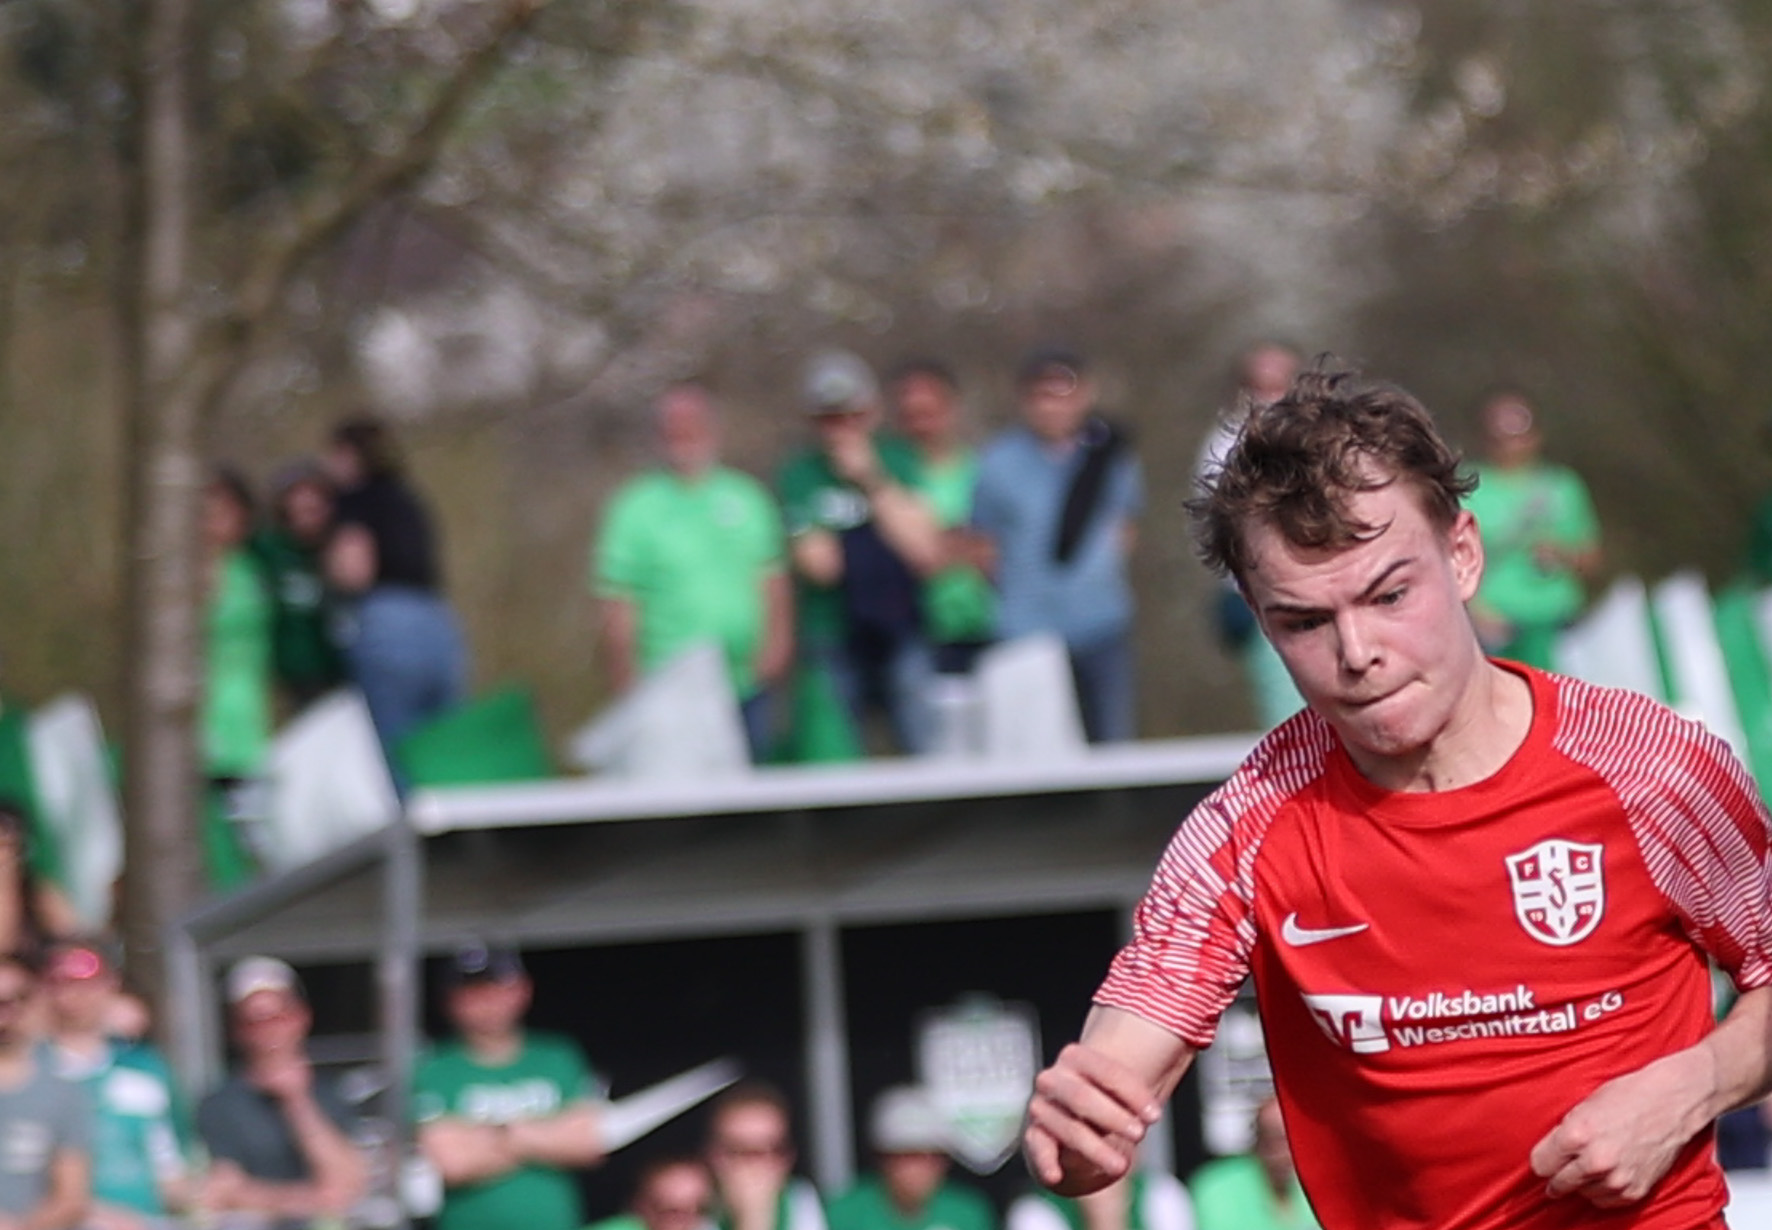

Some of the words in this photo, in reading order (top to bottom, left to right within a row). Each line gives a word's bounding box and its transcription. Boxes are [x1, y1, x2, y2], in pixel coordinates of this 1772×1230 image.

[1523, 862, 1535, 878] F
[1575, 856, 1589, 871] C
[1389, 984, 1534, 1020] Volksbank
[1393, 1004, 1577, 1047] Weschnitztal
[1583, 991, 1623, 1021] eG
